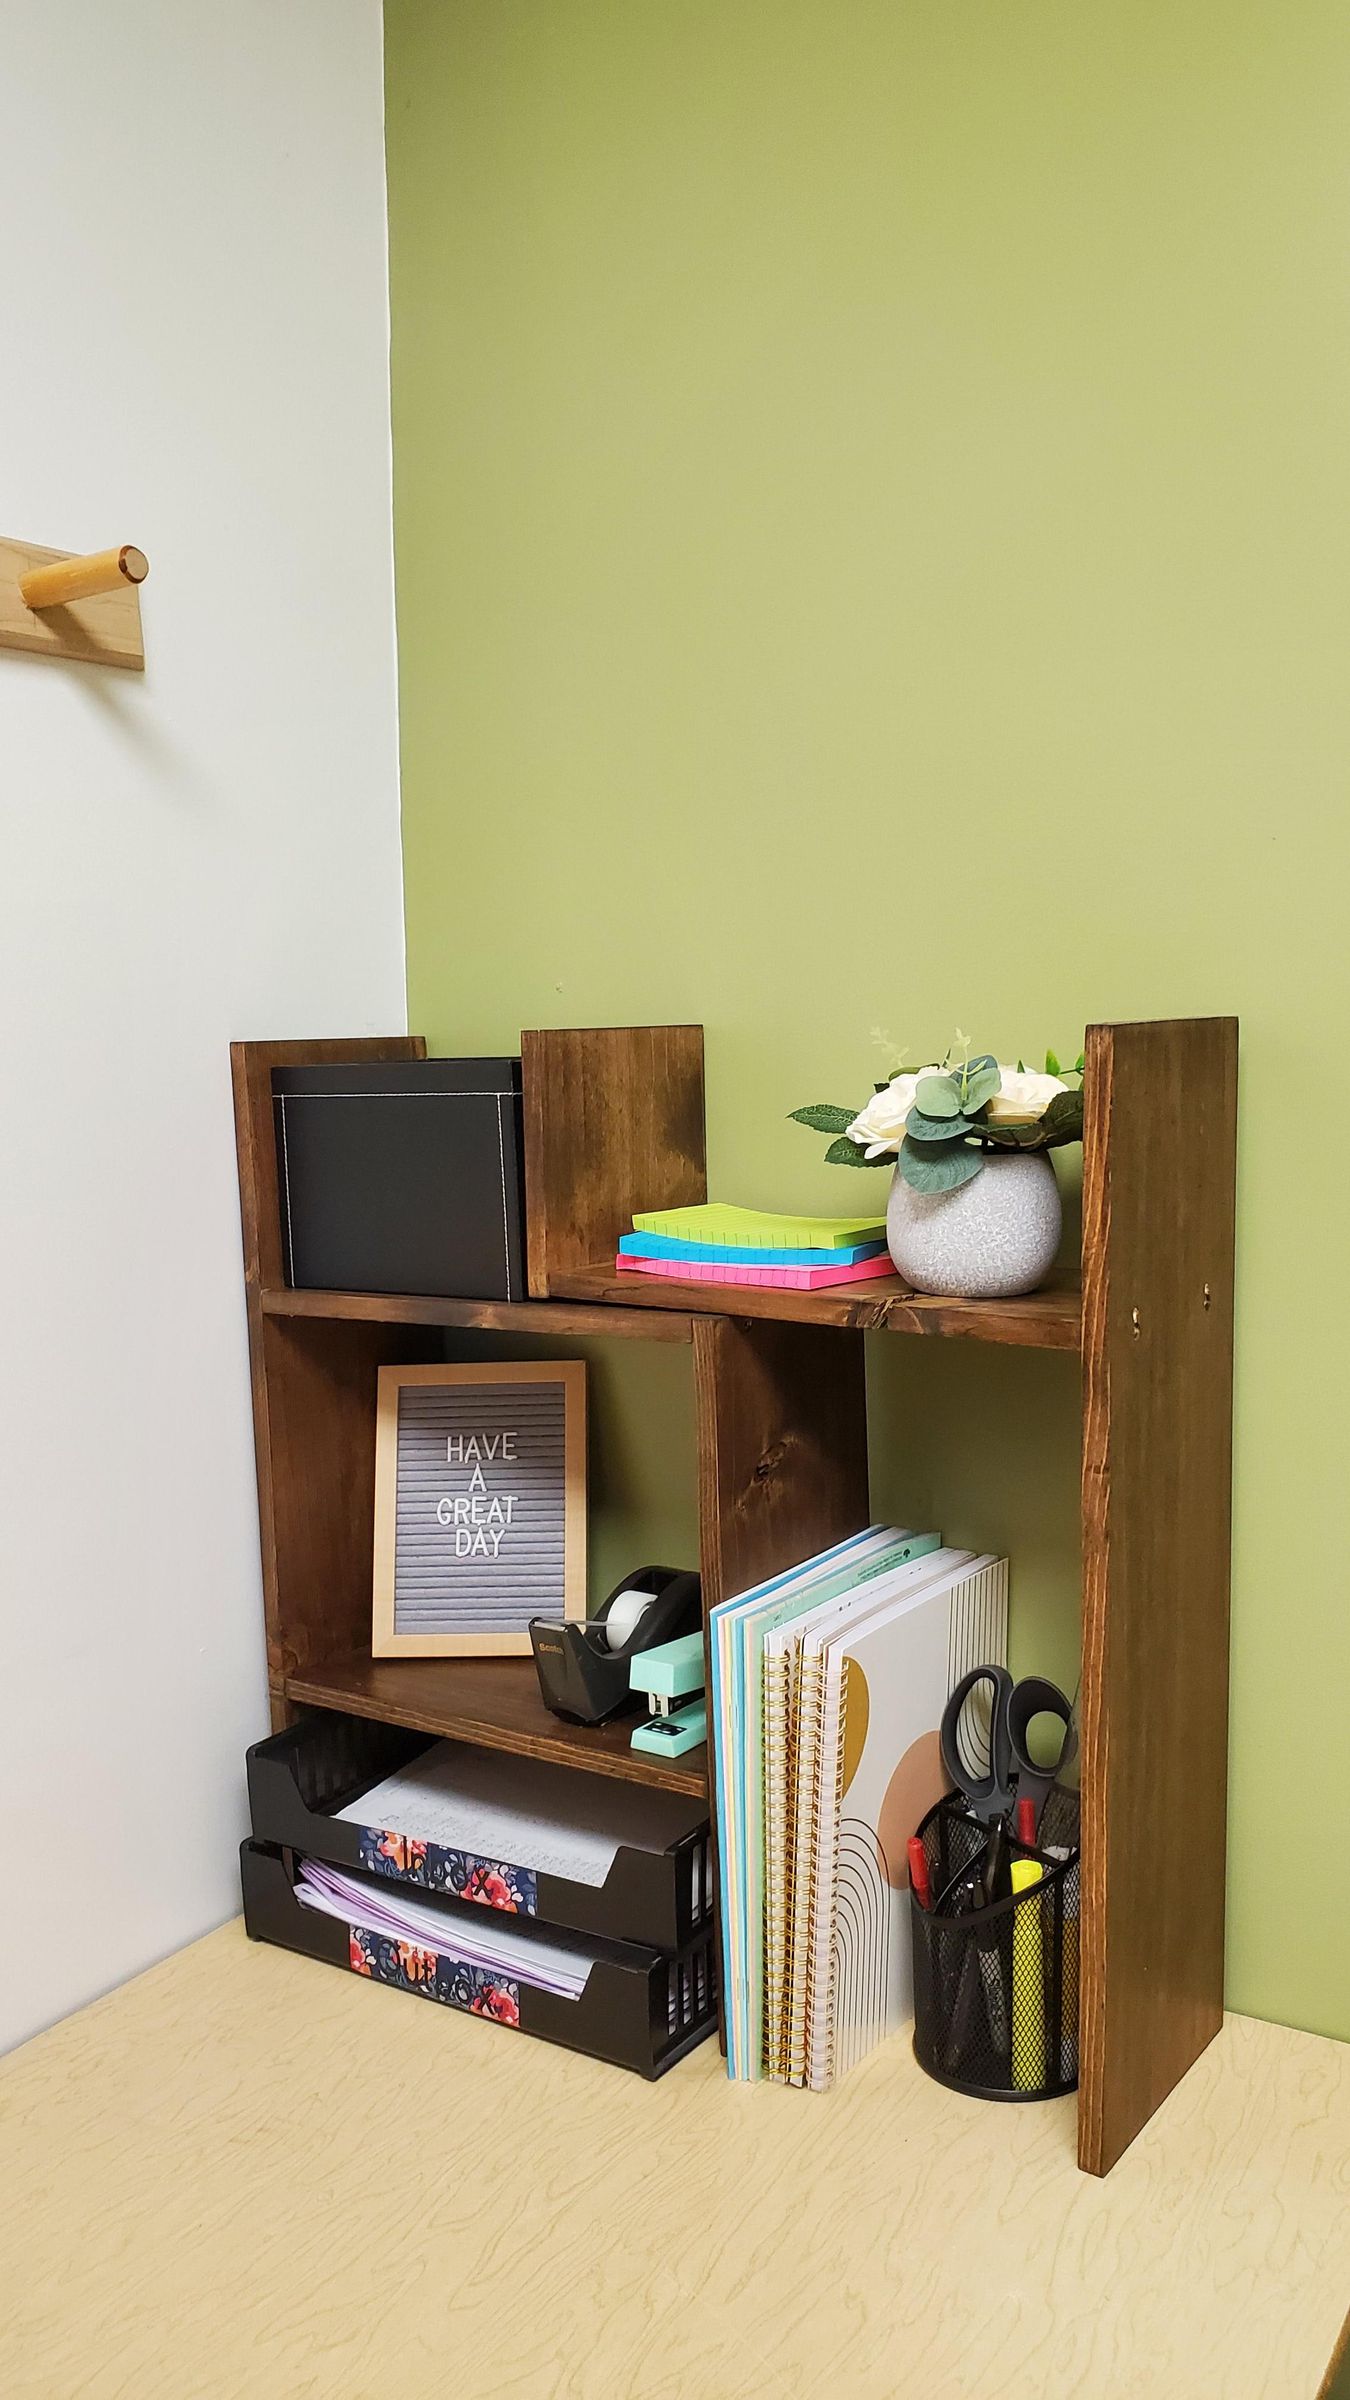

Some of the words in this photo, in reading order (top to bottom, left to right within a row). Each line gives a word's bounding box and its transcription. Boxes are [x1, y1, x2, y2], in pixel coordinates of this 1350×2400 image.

[447, 1432, 518, 1463] HAVE
[468, 1463, 487, 1492] A
[437, 1495, 518, 1526] GREAT
[456, 1527, 505, 1559] DAY
